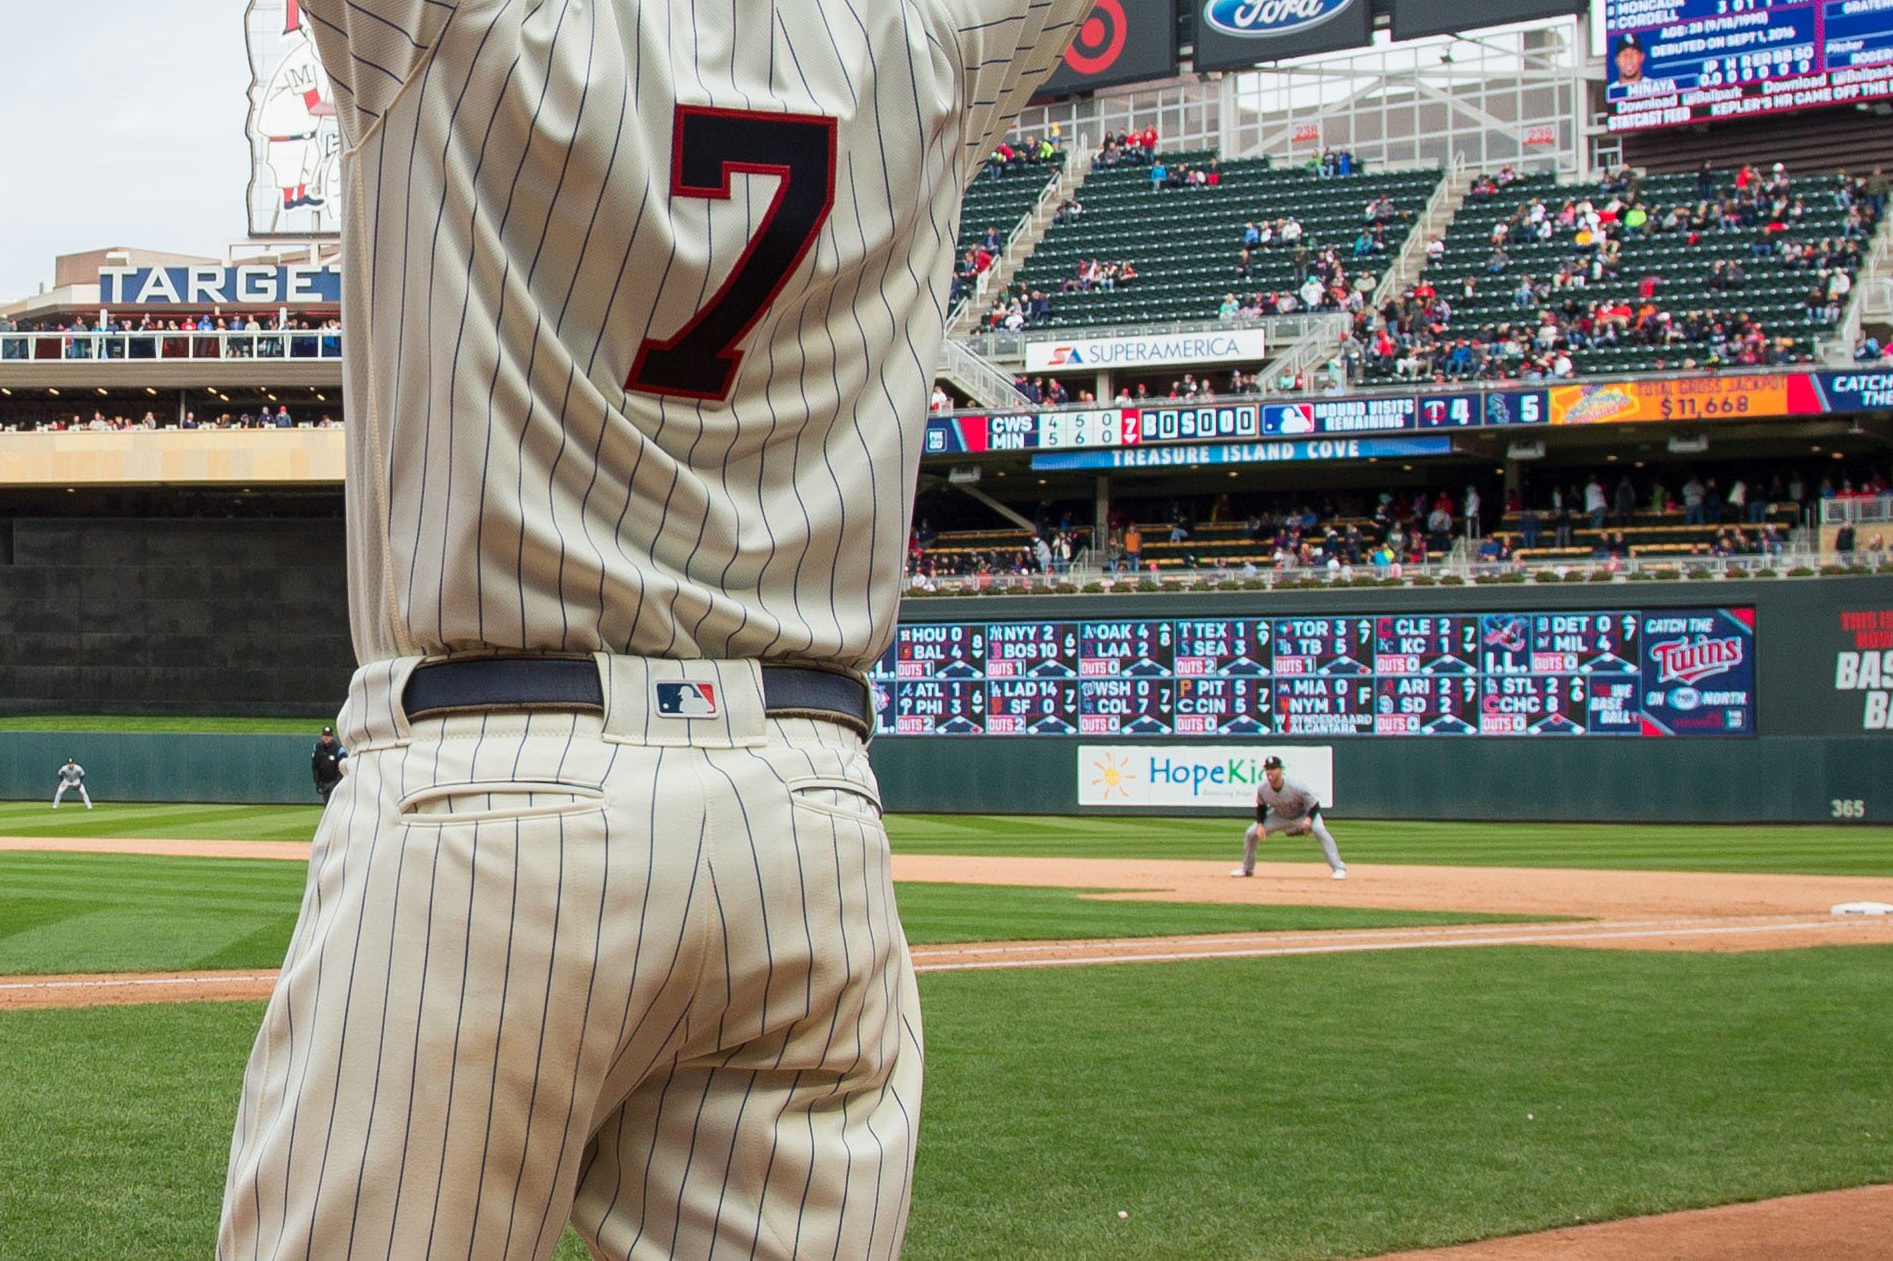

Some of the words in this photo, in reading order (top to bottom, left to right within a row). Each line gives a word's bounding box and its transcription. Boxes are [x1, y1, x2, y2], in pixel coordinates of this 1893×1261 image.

[1627, 80, 1676, 98] MINAYA
[624, 104, 838, 400] 7
[1090, 338, 1240, 363] SUPERAMERICA
[1316, 402, 1366, 418] MOUND
[1368, 399, 1414, 415] VISITS
[992, 415, 1033, 433] CWS
[1326, 414, 1404, 431] REMAINING
[993, 433, 1025, 450] MIN
[1112, 447, 1210, 466] TREASURE
[1222, 442, 1294, 461] ISLAND
[1307, 440, 1360, 458] COVE
[1097, 624, 1131, 639] OAK
[1293, 621, 1328, 636] TOR
[1396, 619, 1430, 635] CLE
[1552, 617, 1589, 633] DET
[912, 627, 946, 642] HOU
[1004, 626, 1036, 641] NYY
[914, 644, 944, 659] BAL
[1004, 643, 1036, 658] BOS
[1193, 641, 1228, 656] SEA
[1648, 634, 1742, 683] Twins
[1004, 683, 1036, 697] LAD
[1098, 699, 1131, 714] COL
[1150, 757, 1286, 796] HopeKi
[1831, 799, 1865, 818] 365
